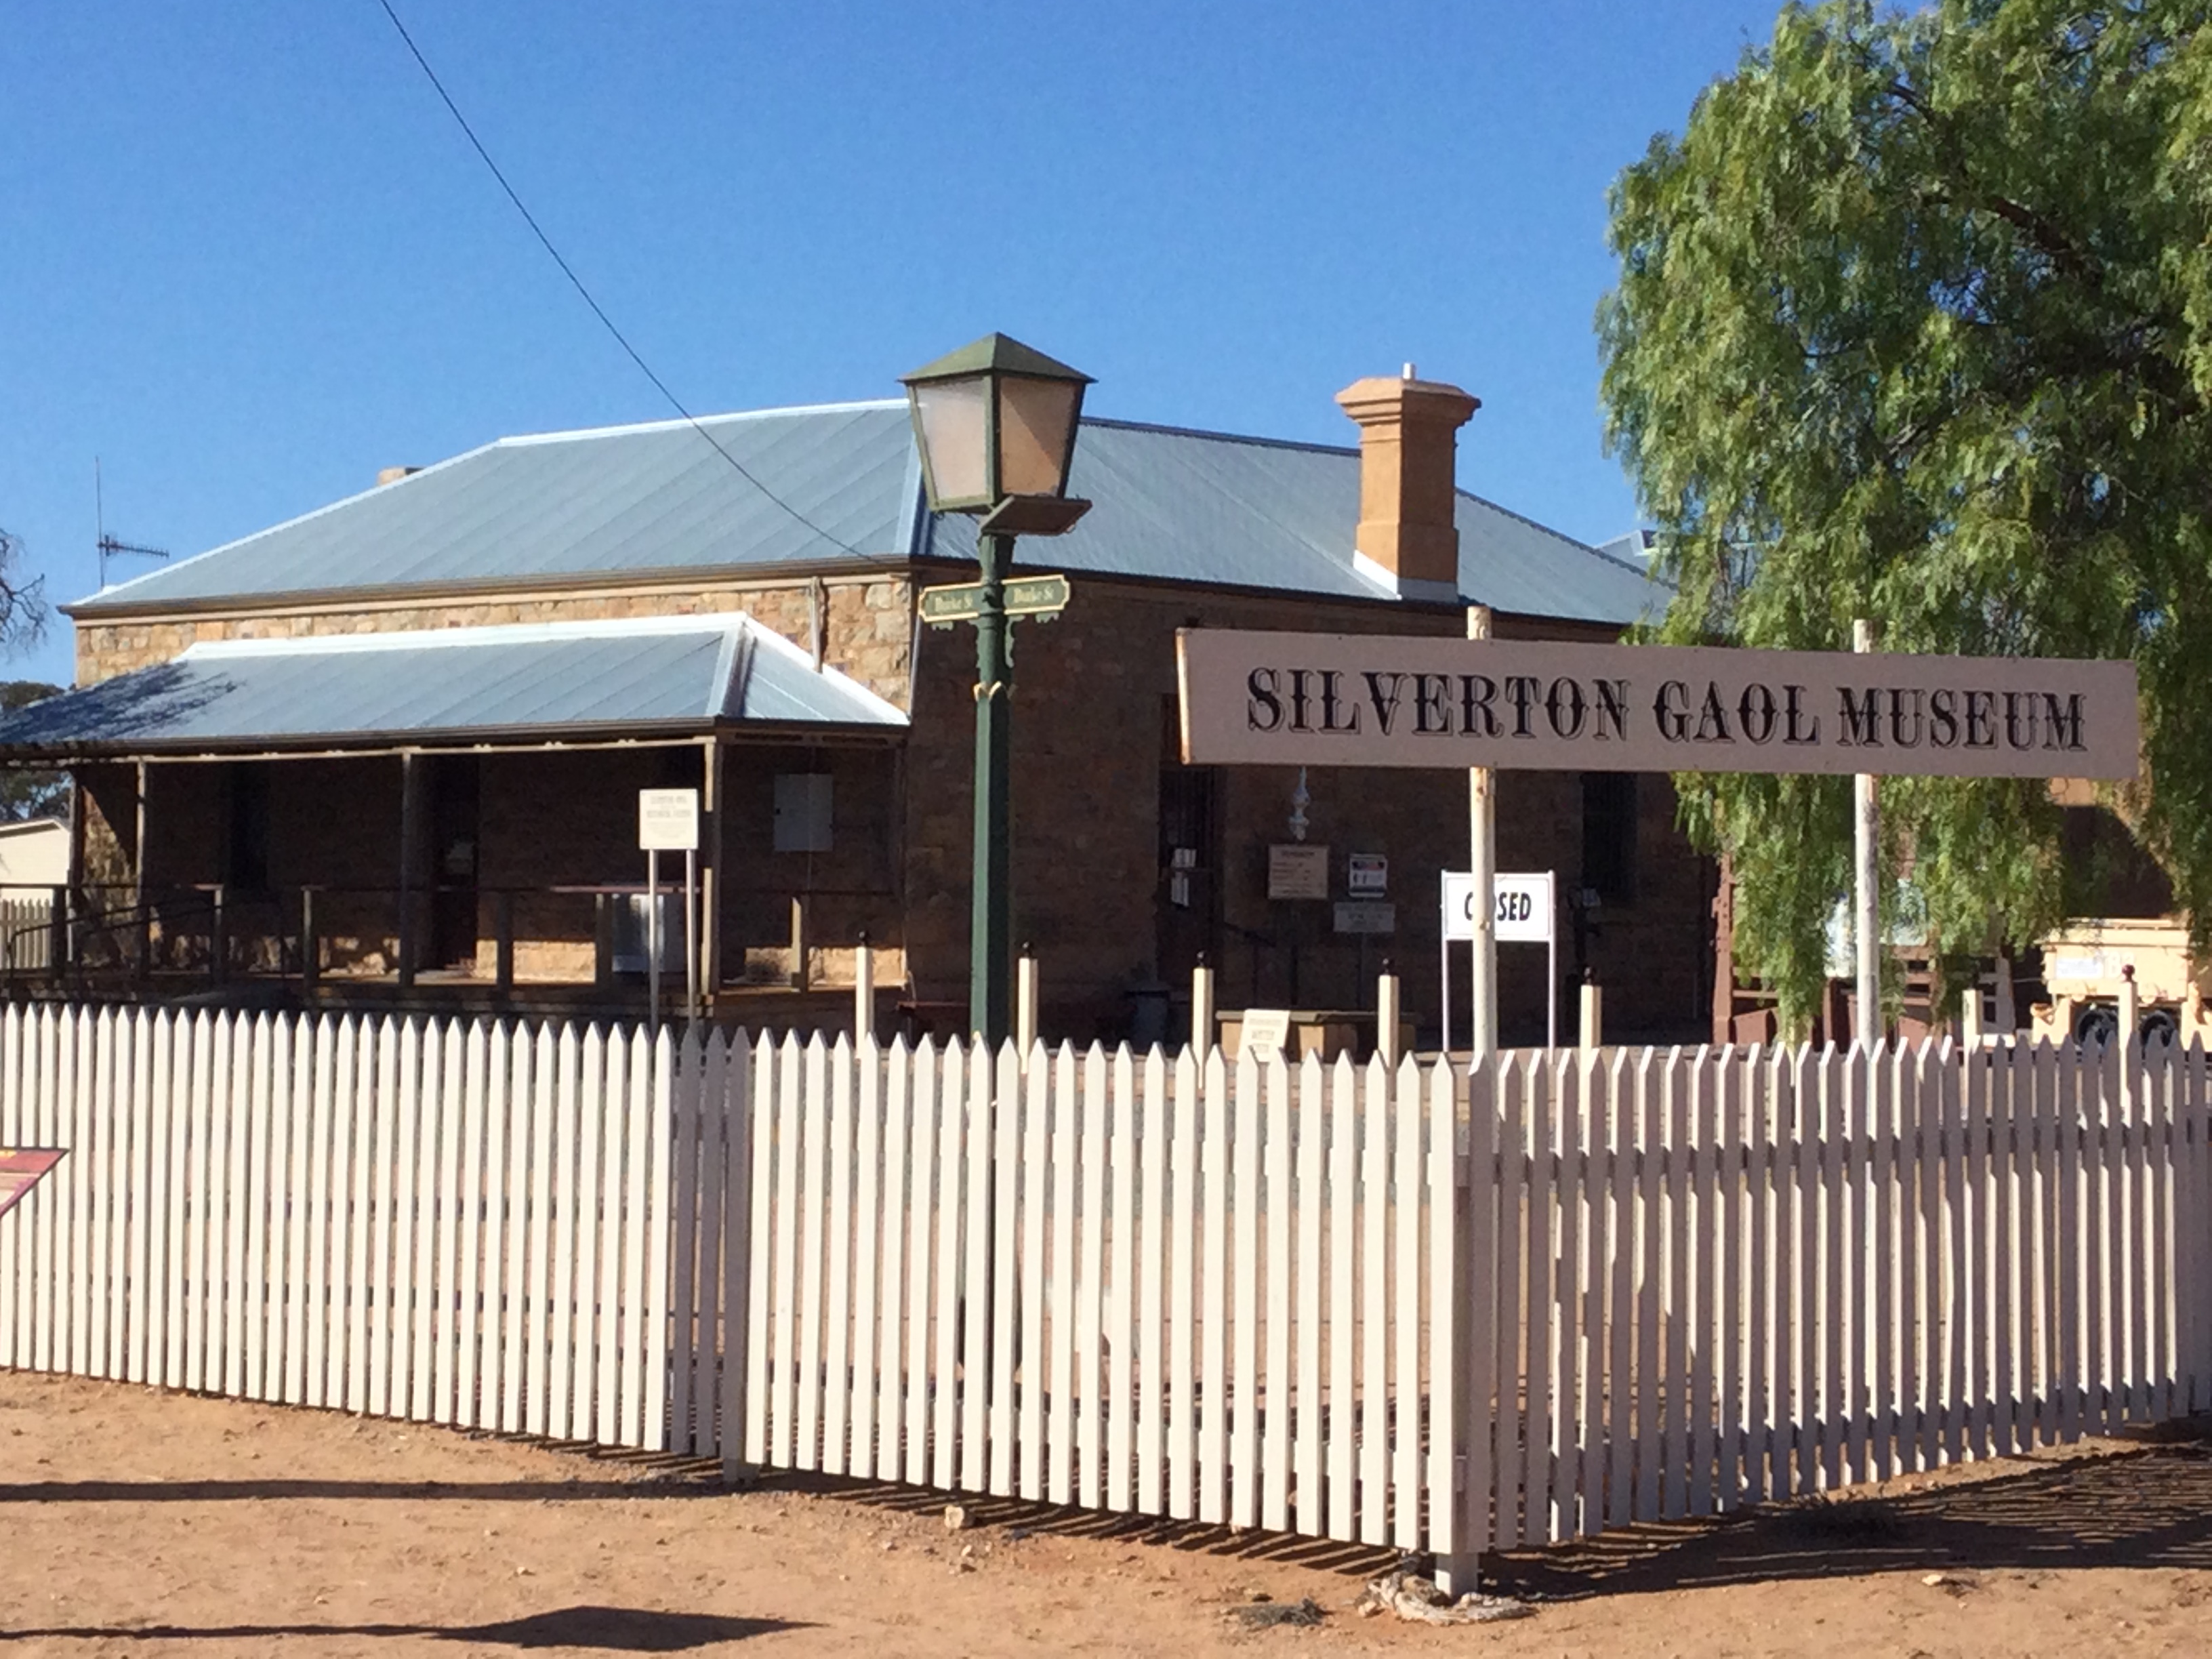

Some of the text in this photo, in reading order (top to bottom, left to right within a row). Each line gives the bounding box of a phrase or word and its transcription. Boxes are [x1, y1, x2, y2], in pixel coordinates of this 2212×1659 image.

[1248, 667, 2088, 752] SILVERTON GAOL MUSEUM
[1464, 891, 1532, 922] CSED
